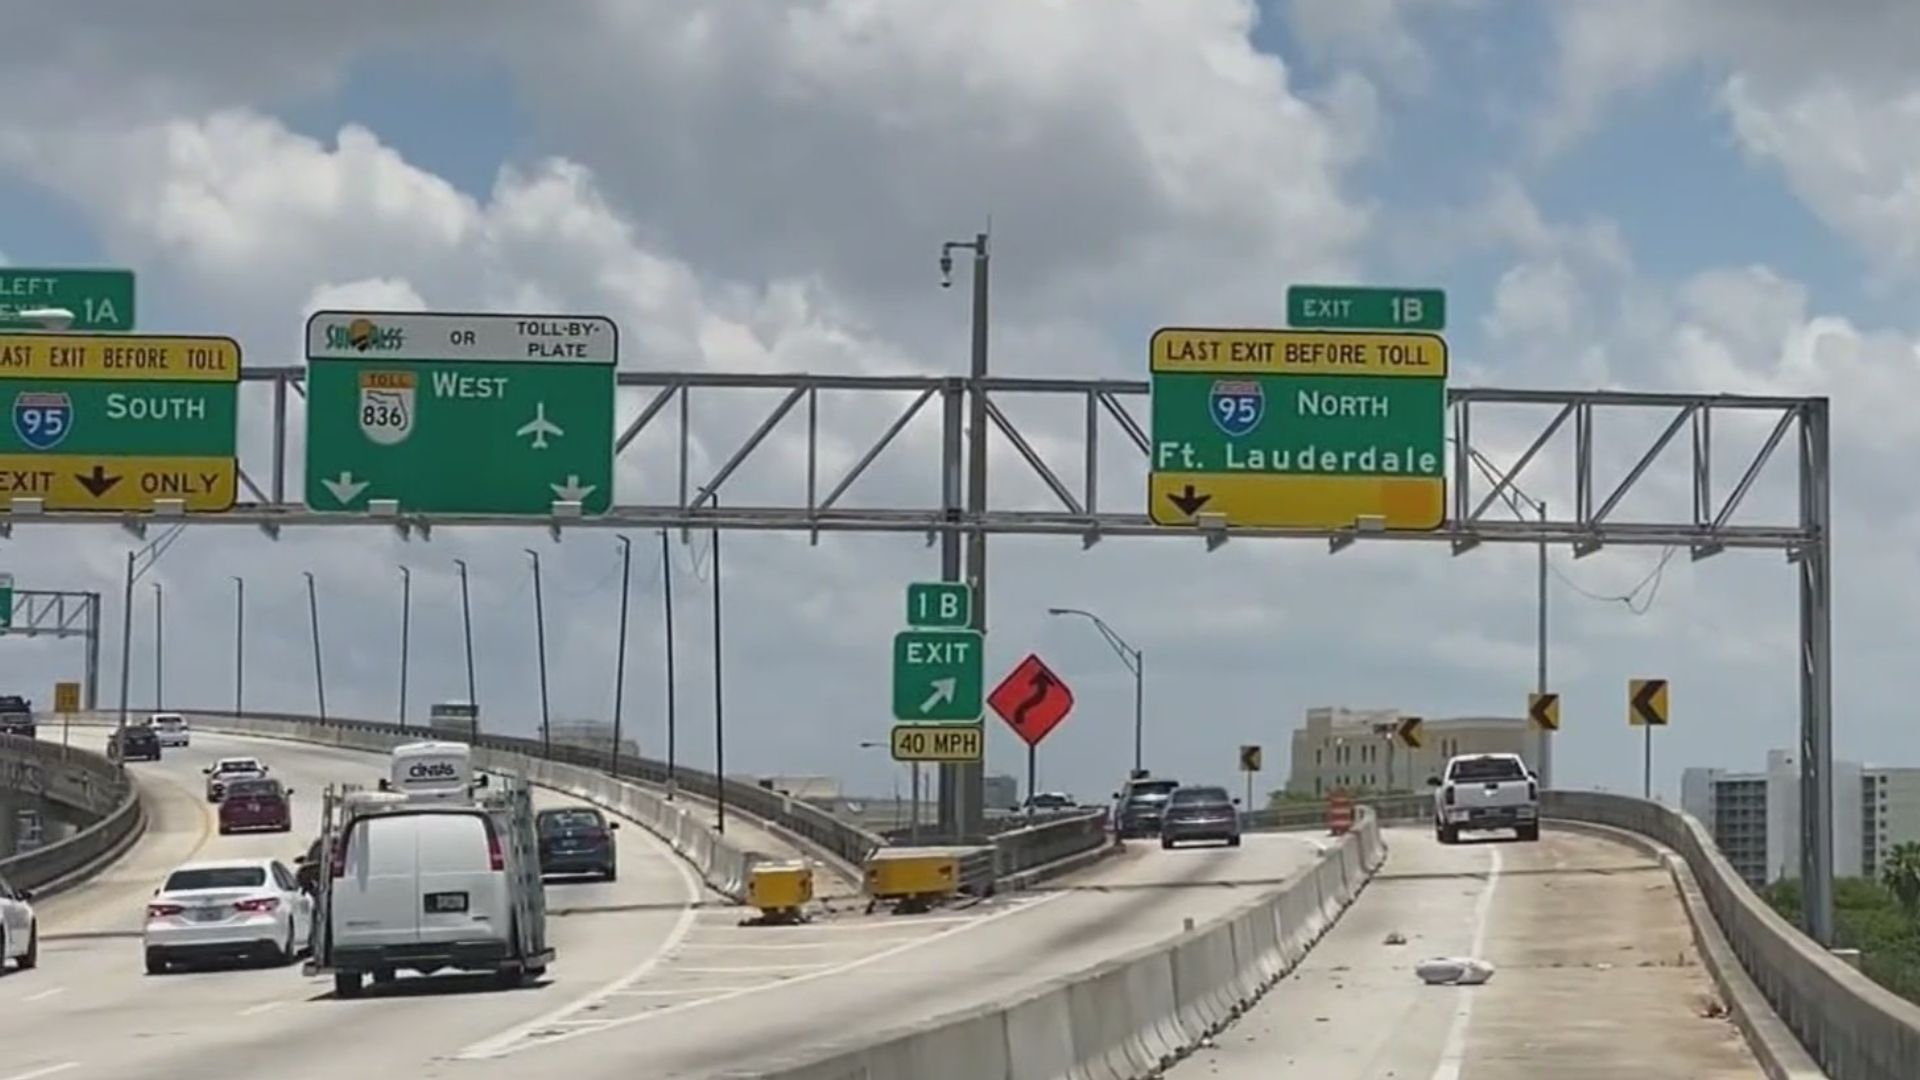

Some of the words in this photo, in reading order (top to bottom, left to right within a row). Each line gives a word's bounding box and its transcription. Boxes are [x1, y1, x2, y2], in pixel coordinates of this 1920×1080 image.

[0, 277, 58, 295] LEFT
[85, 298, 119, 323] 1A
[1302, 299, 1351, 318] EXIT
[1391, 298, 1423, 321] 1B
[450, 331, 476, 346] OR
[0, 346, 32, 367] AST
[50, 348, 85, 368] EXIT
[103, 349, 169, 369] BEFORE
[188, 349, 226, 370] TOLL
[527, 343, 588, 358] PLATE
[1166, 340, 1219, 361] LAST
[1231, 342, 1275, 363] EXIT
[1285, 343, 1367, 364] BEFORE
[1377, 345, 1430, 366] TOLL
[368, 374, 409, 386] TOLL
[363, 405, 402, 427] 836
[1218, 398, 1256, 422] 95
[22, 409, 63, 436] 95
[1159, 442, 1203, 469] Ft.
[1226, 443, 1437, 472] Lauderdale
[0, 471, 56, 491] EXIT
[141, 473, 219, 493] ONLY
[906, 642, 969, 664] EXIT
[900, 733, 925, 754] 40
[934, 733, 977, 754] MPH
